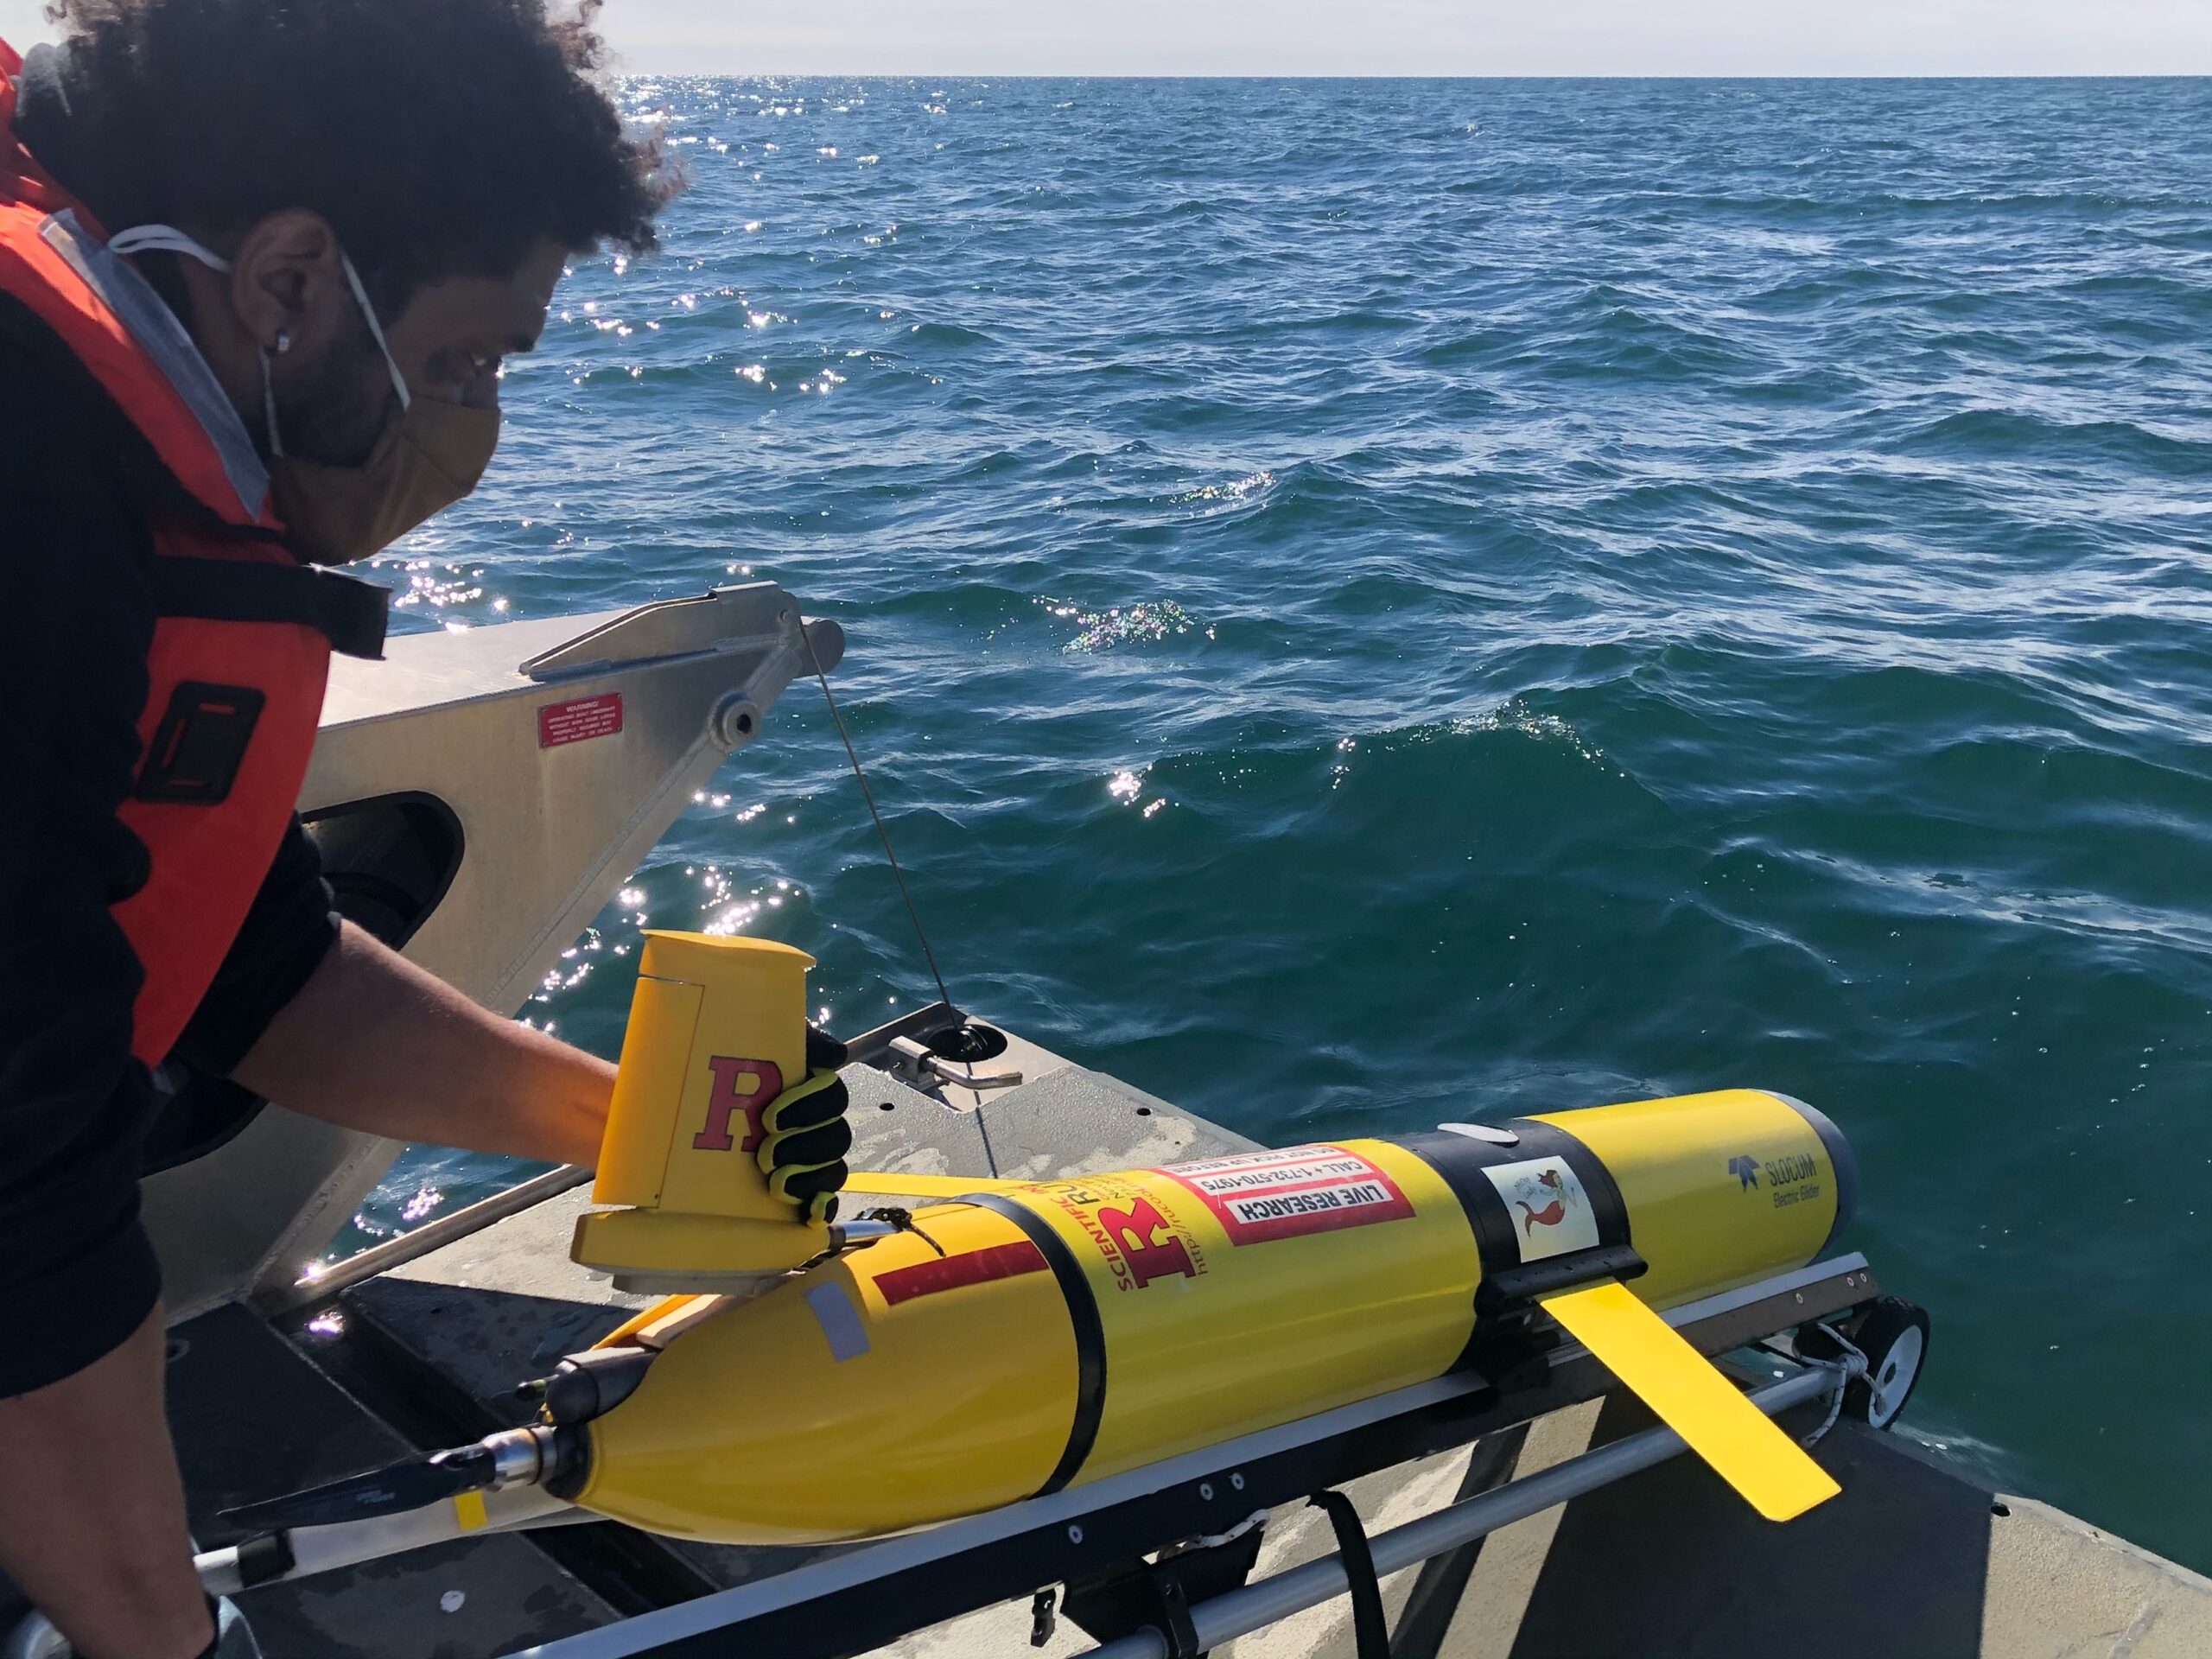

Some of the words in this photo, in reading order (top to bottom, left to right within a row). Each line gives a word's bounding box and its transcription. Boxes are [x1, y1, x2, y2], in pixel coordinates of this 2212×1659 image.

[692, 1054, 784, 1153] R
[1322, 1161, 1363, 1173] CALL
[1764, 1153, 1818, 1187] SLOCUM
[1236, 1190, 1338, 1221] RESEARCH
[1343, 1184, 1385, 1205] LIVE
[1773, 1190, 1799, 1209] Electric
[1800, 1184, 1820, 1202] Glider
[1049, 1196, 1134, 1292] SCIENTIFIC
[1097, 1197, 1197, 1289] R
